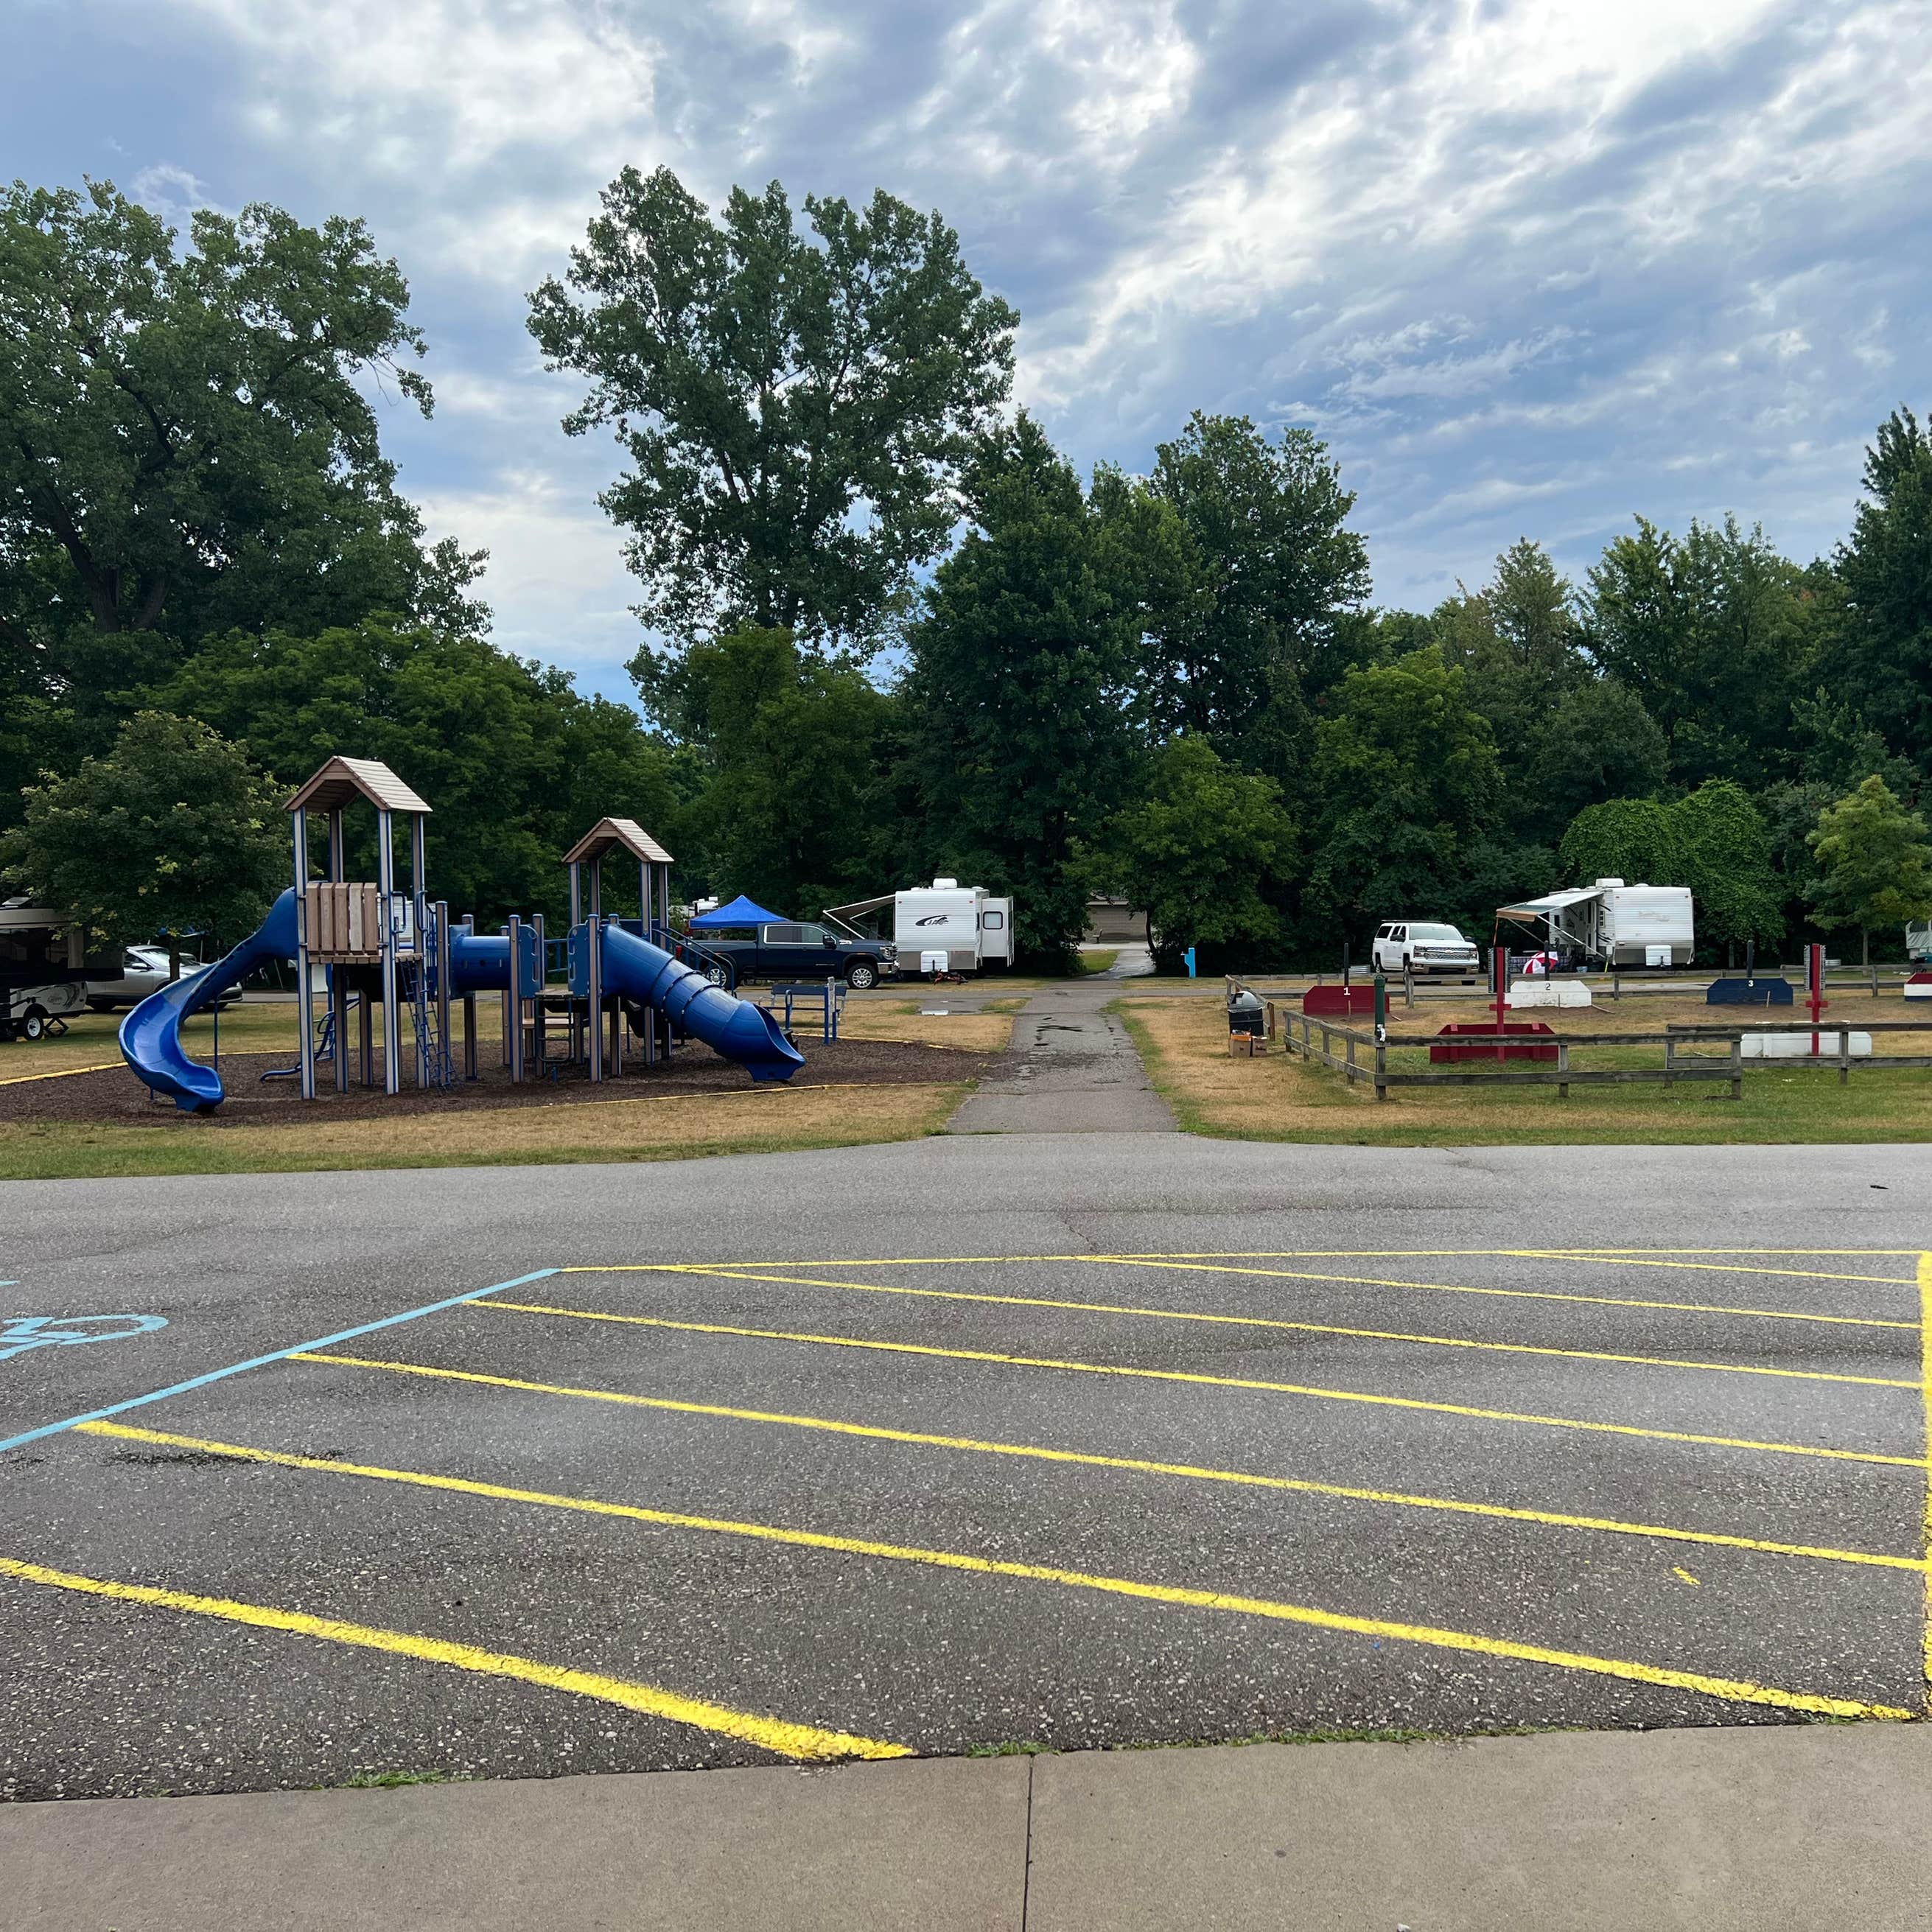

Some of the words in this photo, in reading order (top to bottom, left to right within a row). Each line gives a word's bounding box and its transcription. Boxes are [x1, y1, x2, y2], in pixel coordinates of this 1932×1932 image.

[1545, 983, 1551, 991] 2
[1748, 979, 1754, 987] 3
[1343, 987, 1351, 995] 1
